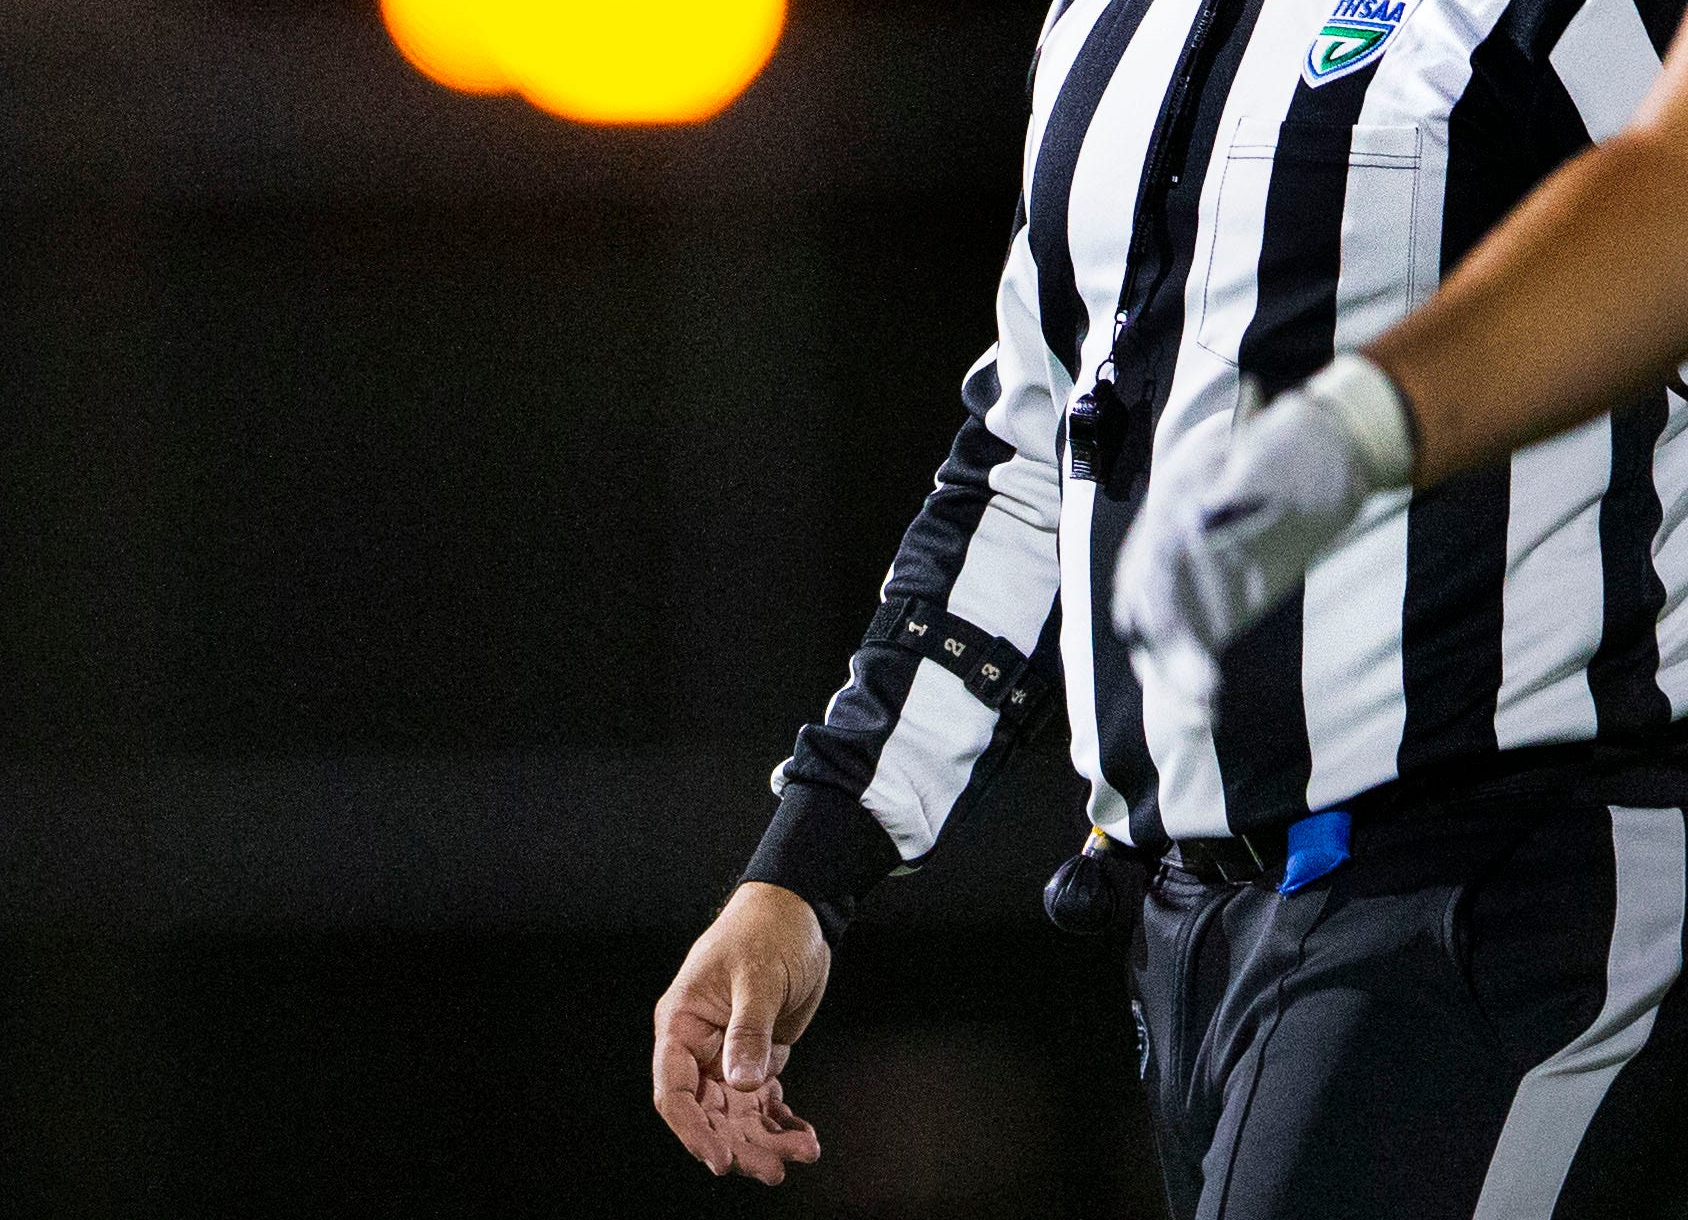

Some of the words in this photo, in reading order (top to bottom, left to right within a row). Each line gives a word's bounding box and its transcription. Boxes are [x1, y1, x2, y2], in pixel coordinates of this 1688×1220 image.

[908, 621, 929, 637] 1
[944, 638, 966, 657] 2
[982, 663, 1001, 681] 3
